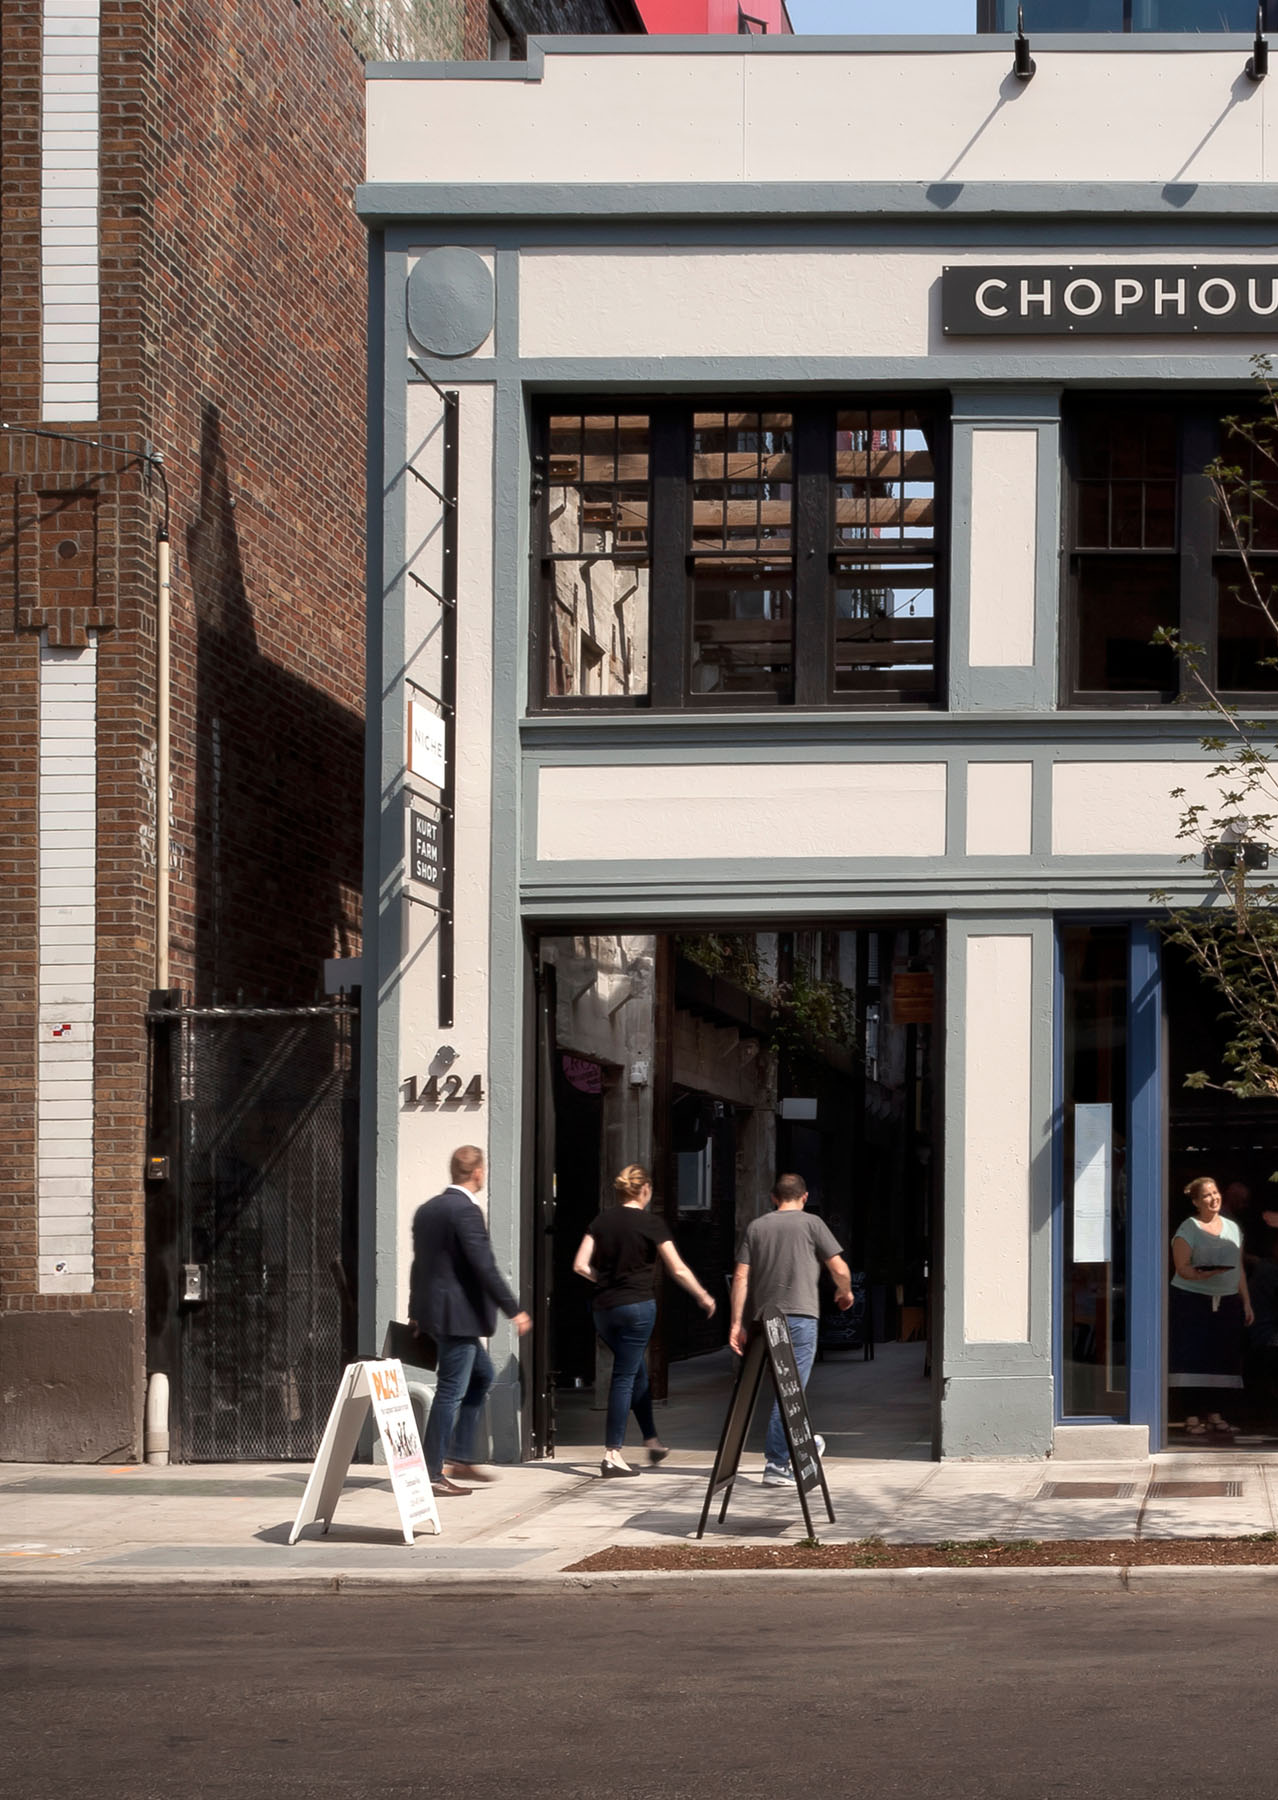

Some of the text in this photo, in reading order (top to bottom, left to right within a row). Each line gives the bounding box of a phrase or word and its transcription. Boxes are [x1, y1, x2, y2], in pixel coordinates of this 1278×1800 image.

[414, 728, 443, 758] NICHE
[416, 817, 437, 841] KURT
[416, 838, 438, 862] FARM
[416, 860, 438, 882] SHOP
[402, 1074, 485, 1104] 1424
[371, 1368, 400, 1401] PLAY
